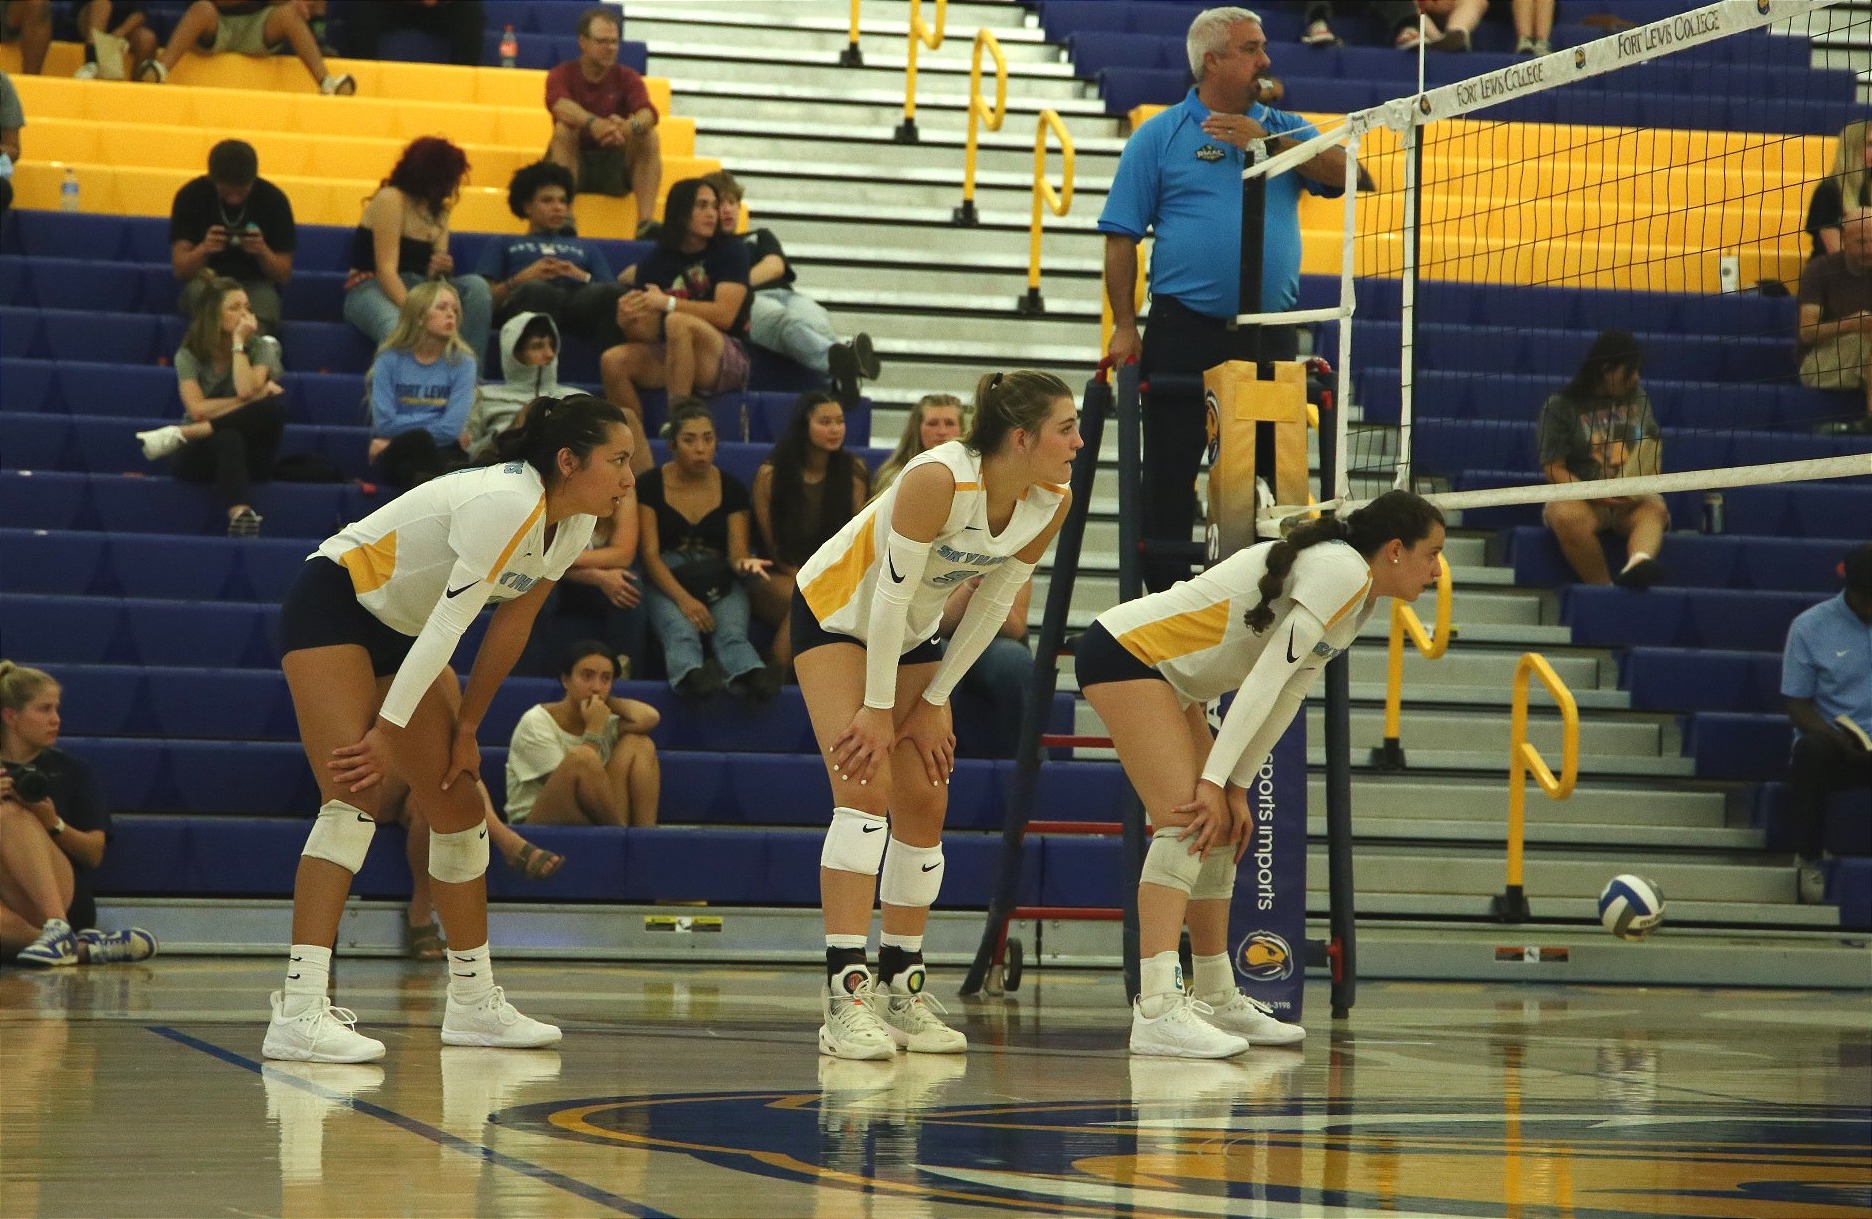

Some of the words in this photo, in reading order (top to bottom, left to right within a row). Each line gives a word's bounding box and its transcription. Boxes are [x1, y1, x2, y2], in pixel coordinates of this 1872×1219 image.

[1618, 33, 1642, 58] FORT
[1645, 27, 1672, 50] LEWIS
[1674, 10, 1720, 41] COLLEGE
[1456, 83, 1478, 106] FORT
[1480, 77, 1504, 99] LEWIS
[1504, 63, 1543, 91] COLLEGE
[1258, 752, 1276, 822] sports
[1254, 825, 1276, 911] imports
